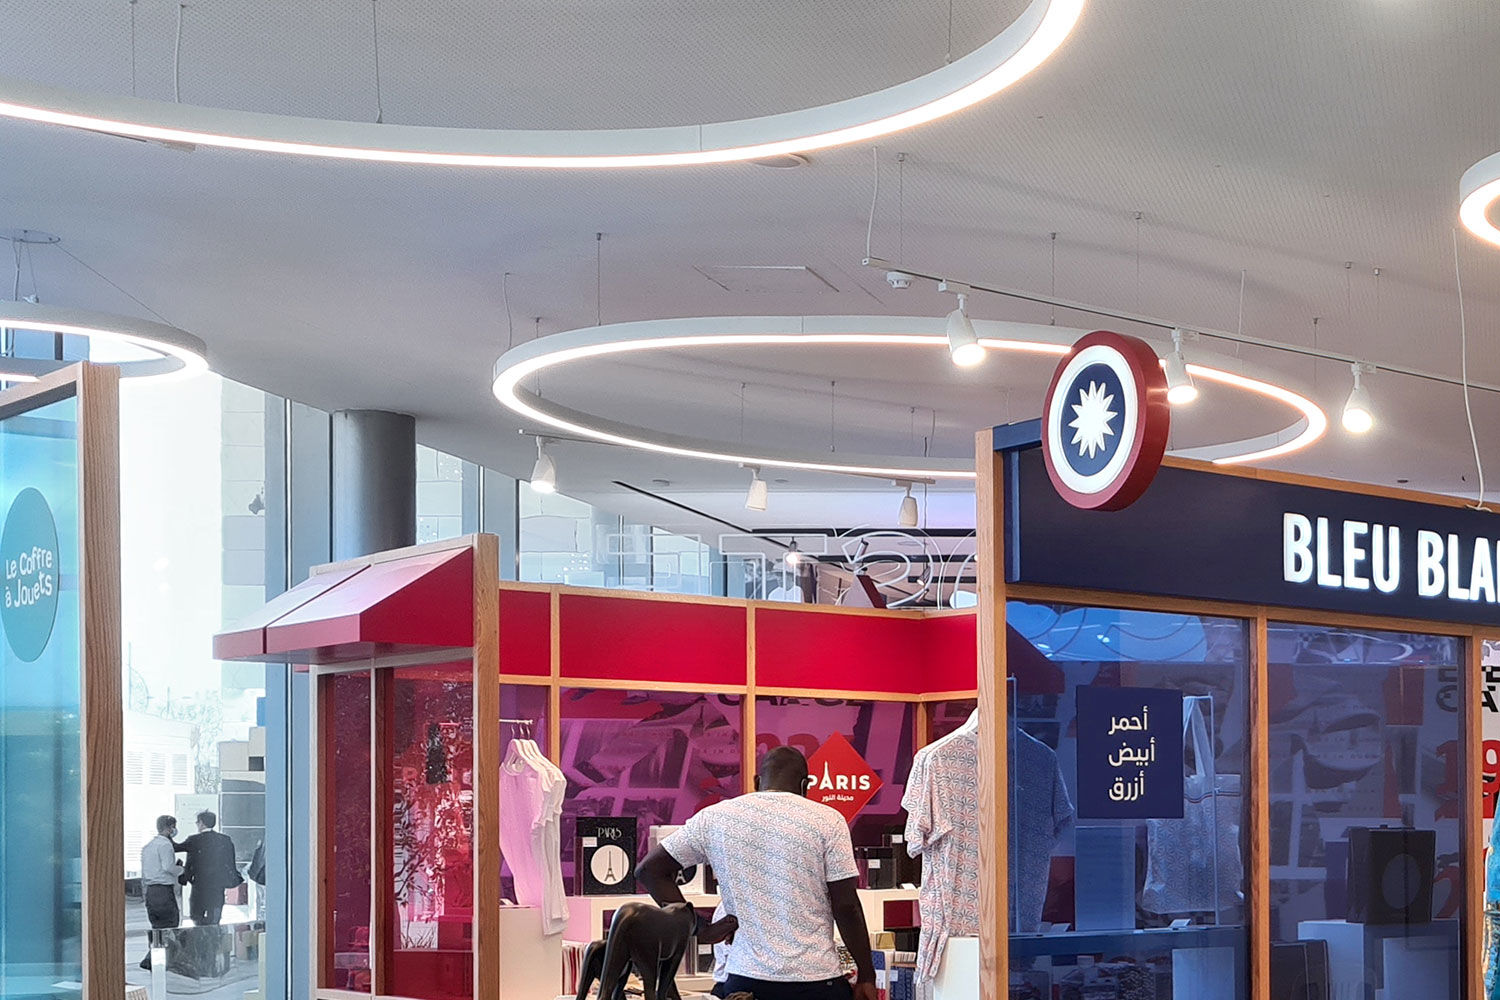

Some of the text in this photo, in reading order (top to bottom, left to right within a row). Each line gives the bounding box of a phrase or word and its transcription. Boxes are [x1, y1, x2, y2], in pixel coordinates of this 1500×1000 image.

[6, 546, 53, 579] Le Coffre
[1283, 512, 1400, 593] BLEU
[14, 571, 53, 607] Jouets
[1108, 705, 1148, 735] أحمر
[1108, 736, 1156, 767] أبيض
[807, 760, 871, 791] PARIS
[1108, 770, 1145, 801] أزرق
[597, 827, 622, 840] PARIS
